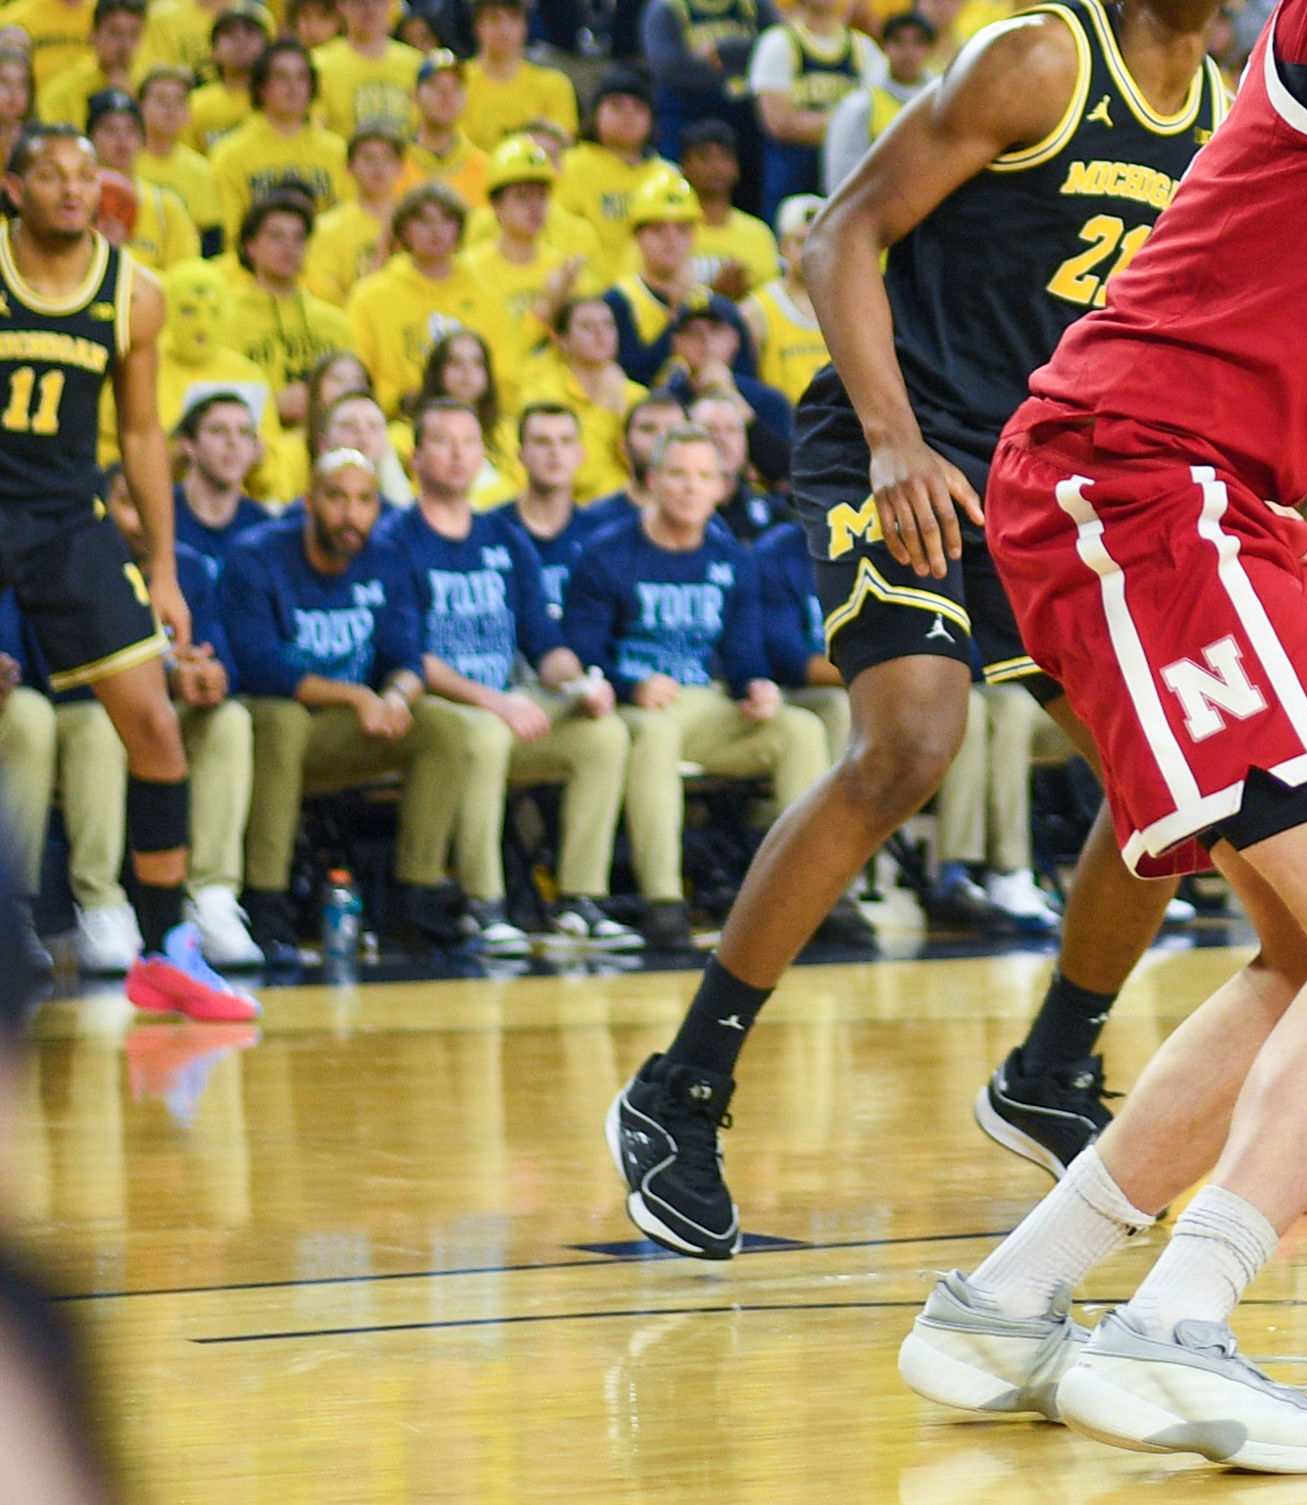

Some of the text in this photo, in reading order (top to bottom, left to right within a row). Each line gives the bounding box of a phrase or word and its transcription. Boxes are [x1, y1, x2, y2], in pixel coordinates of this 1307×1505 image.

[1060, 160, 1182, 212] MICHIG
[3, 365, 65, 436] 11
[1159, 634, 1266, 744] N
